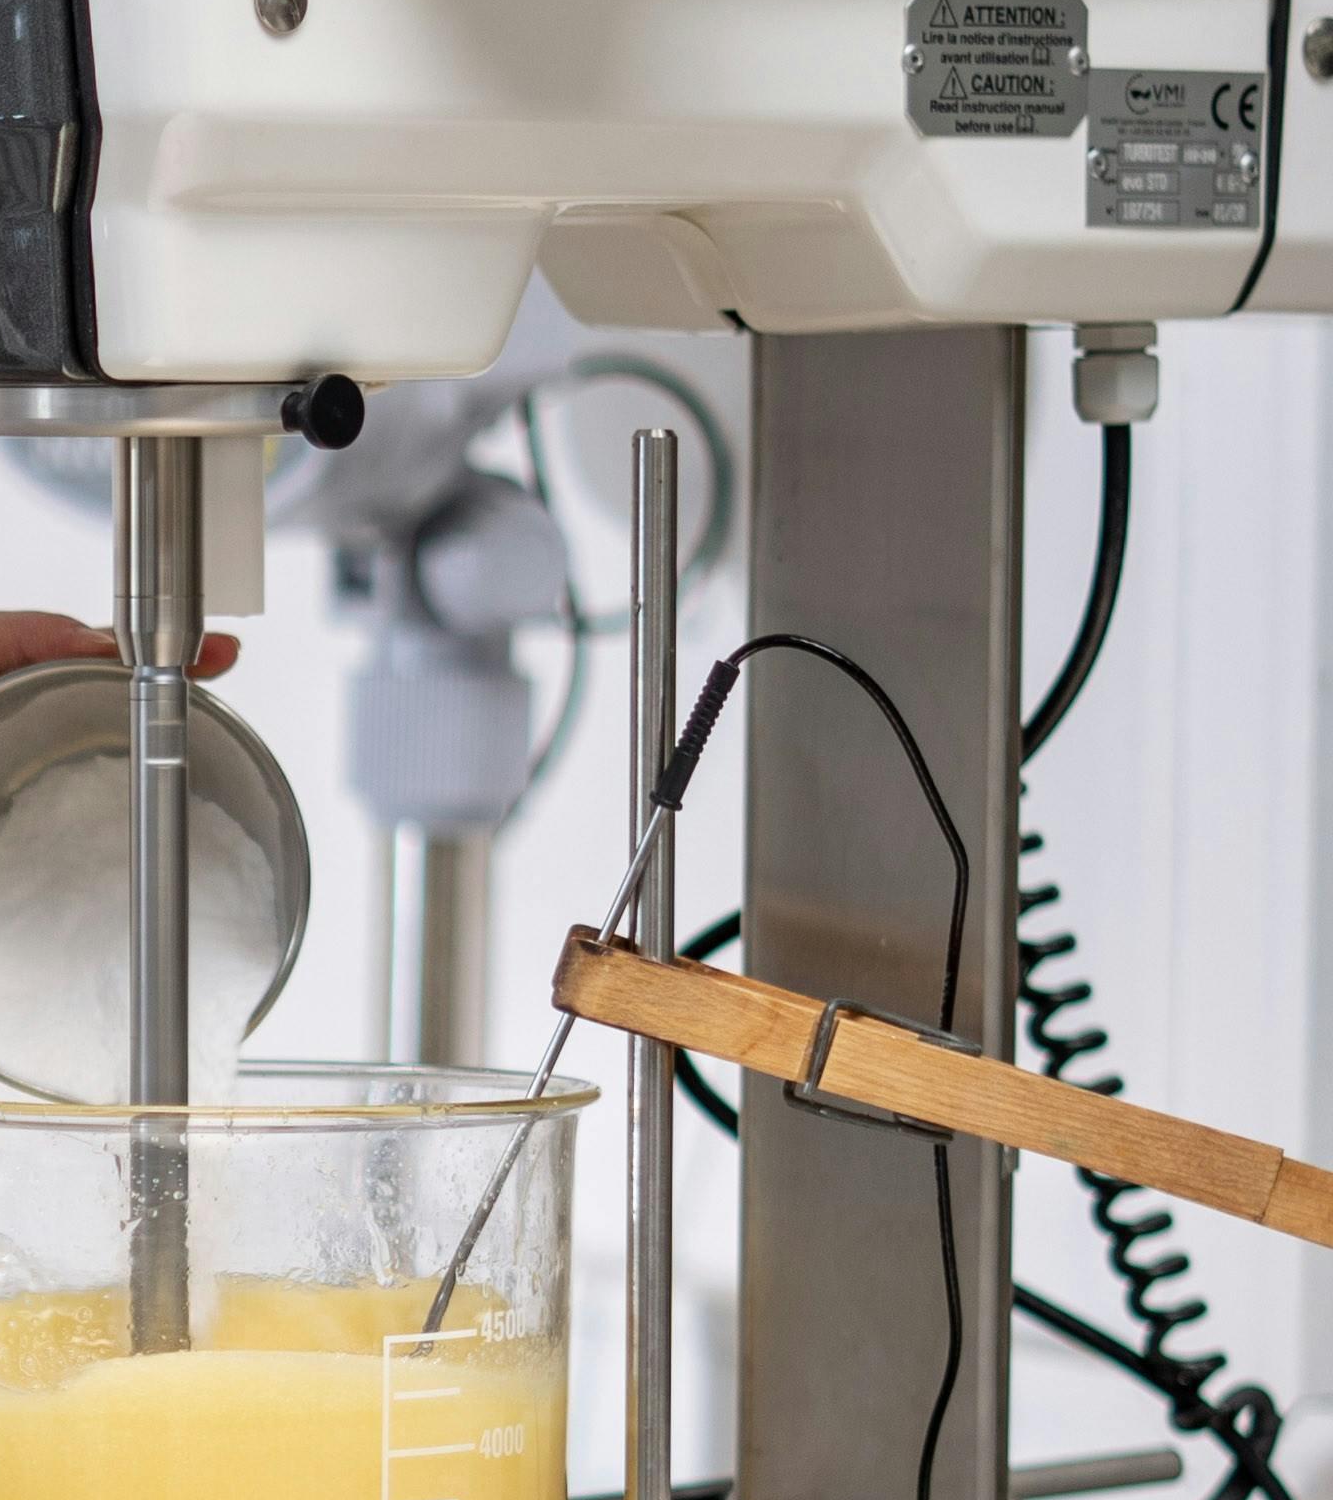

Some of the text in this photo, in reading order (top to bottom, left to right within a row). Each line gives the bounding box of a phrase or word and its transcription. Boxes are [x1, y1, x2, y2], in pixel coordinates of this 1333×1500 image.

[921, 31, 1074, 48] Lire la notice d'instructions
[940, 51, 1030, 66] avant utilisation
[1152, 84, 1186, 102] VMI
[929, 100, 1065, 116] Read instruction manual
[955, 120, 1014, 134] before use
[481, 1308, 526, 1343] 4500
[478, 1423, 525, 1461] 4000
